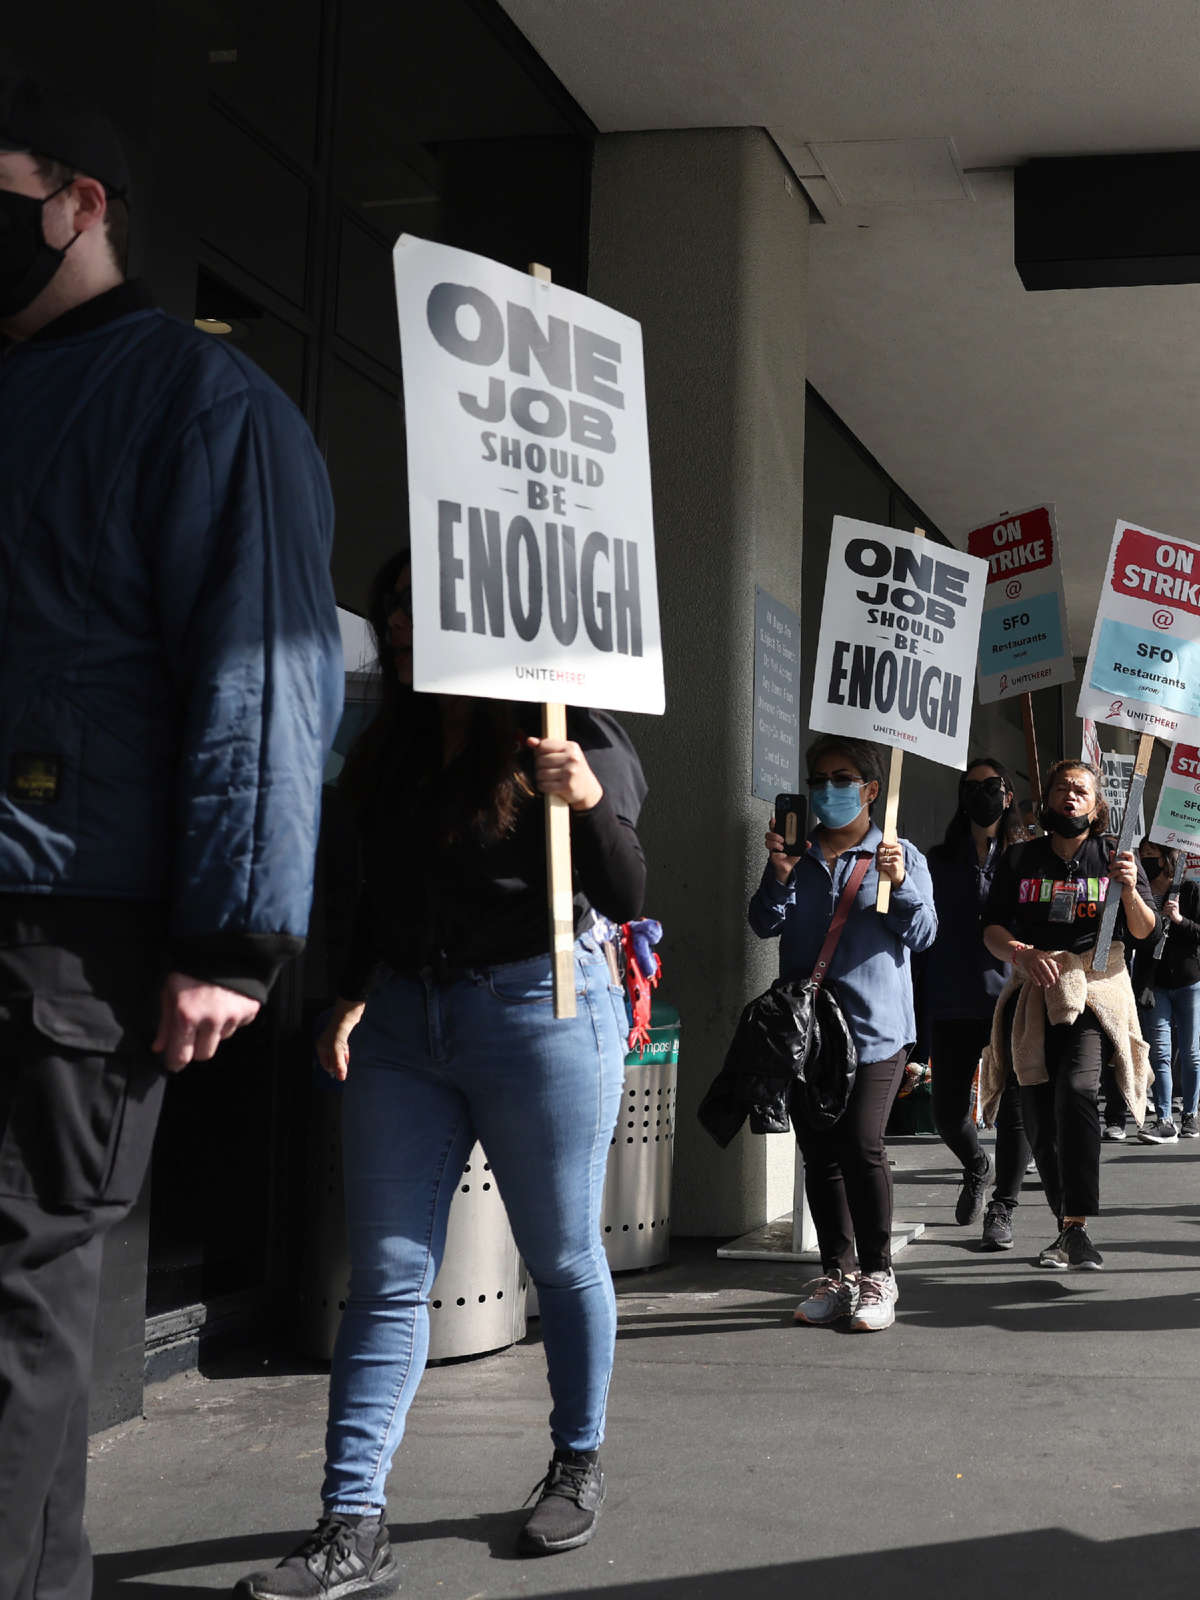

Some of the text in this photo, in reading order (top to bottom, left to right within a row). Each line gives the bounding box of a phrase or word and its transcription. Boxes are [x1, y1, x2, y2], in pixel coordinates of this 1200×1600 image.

[426, 282, 625, 411] ONE
[458, 376, 617, 455] JOB
[481, 431, 605, 488] SHOULD
[527, 479, 567, 516] BE
[992, 519, 1022, 547] ON
[988, 539, 1046, 575] TRIKE
[1155, 544, 1195, 574] ON
[438, 499, 644, 658] ENOUGH
[844, 538, 970, 607] ONE
[1005, 580, 1022, 600] @
[856, 582, 956, 629] JOB
[1152, 609, 1174, 629] @
[867, 608, 944, 644] SHOULD
[1002, 613, 1030, 631] SFO
[894, 633, 919, 655] BE
[992, 632, 1047, 654] Restaurants
[1136, 642, 1174, 664] SFO
[827, 640, 962, 738] ENOUGH
[1113, 662, 1187, 691] Restaurants
[873, 724, 918, 743] UNITEHERE!
[1126, 708, 1178, 730] UNITEHERE!
